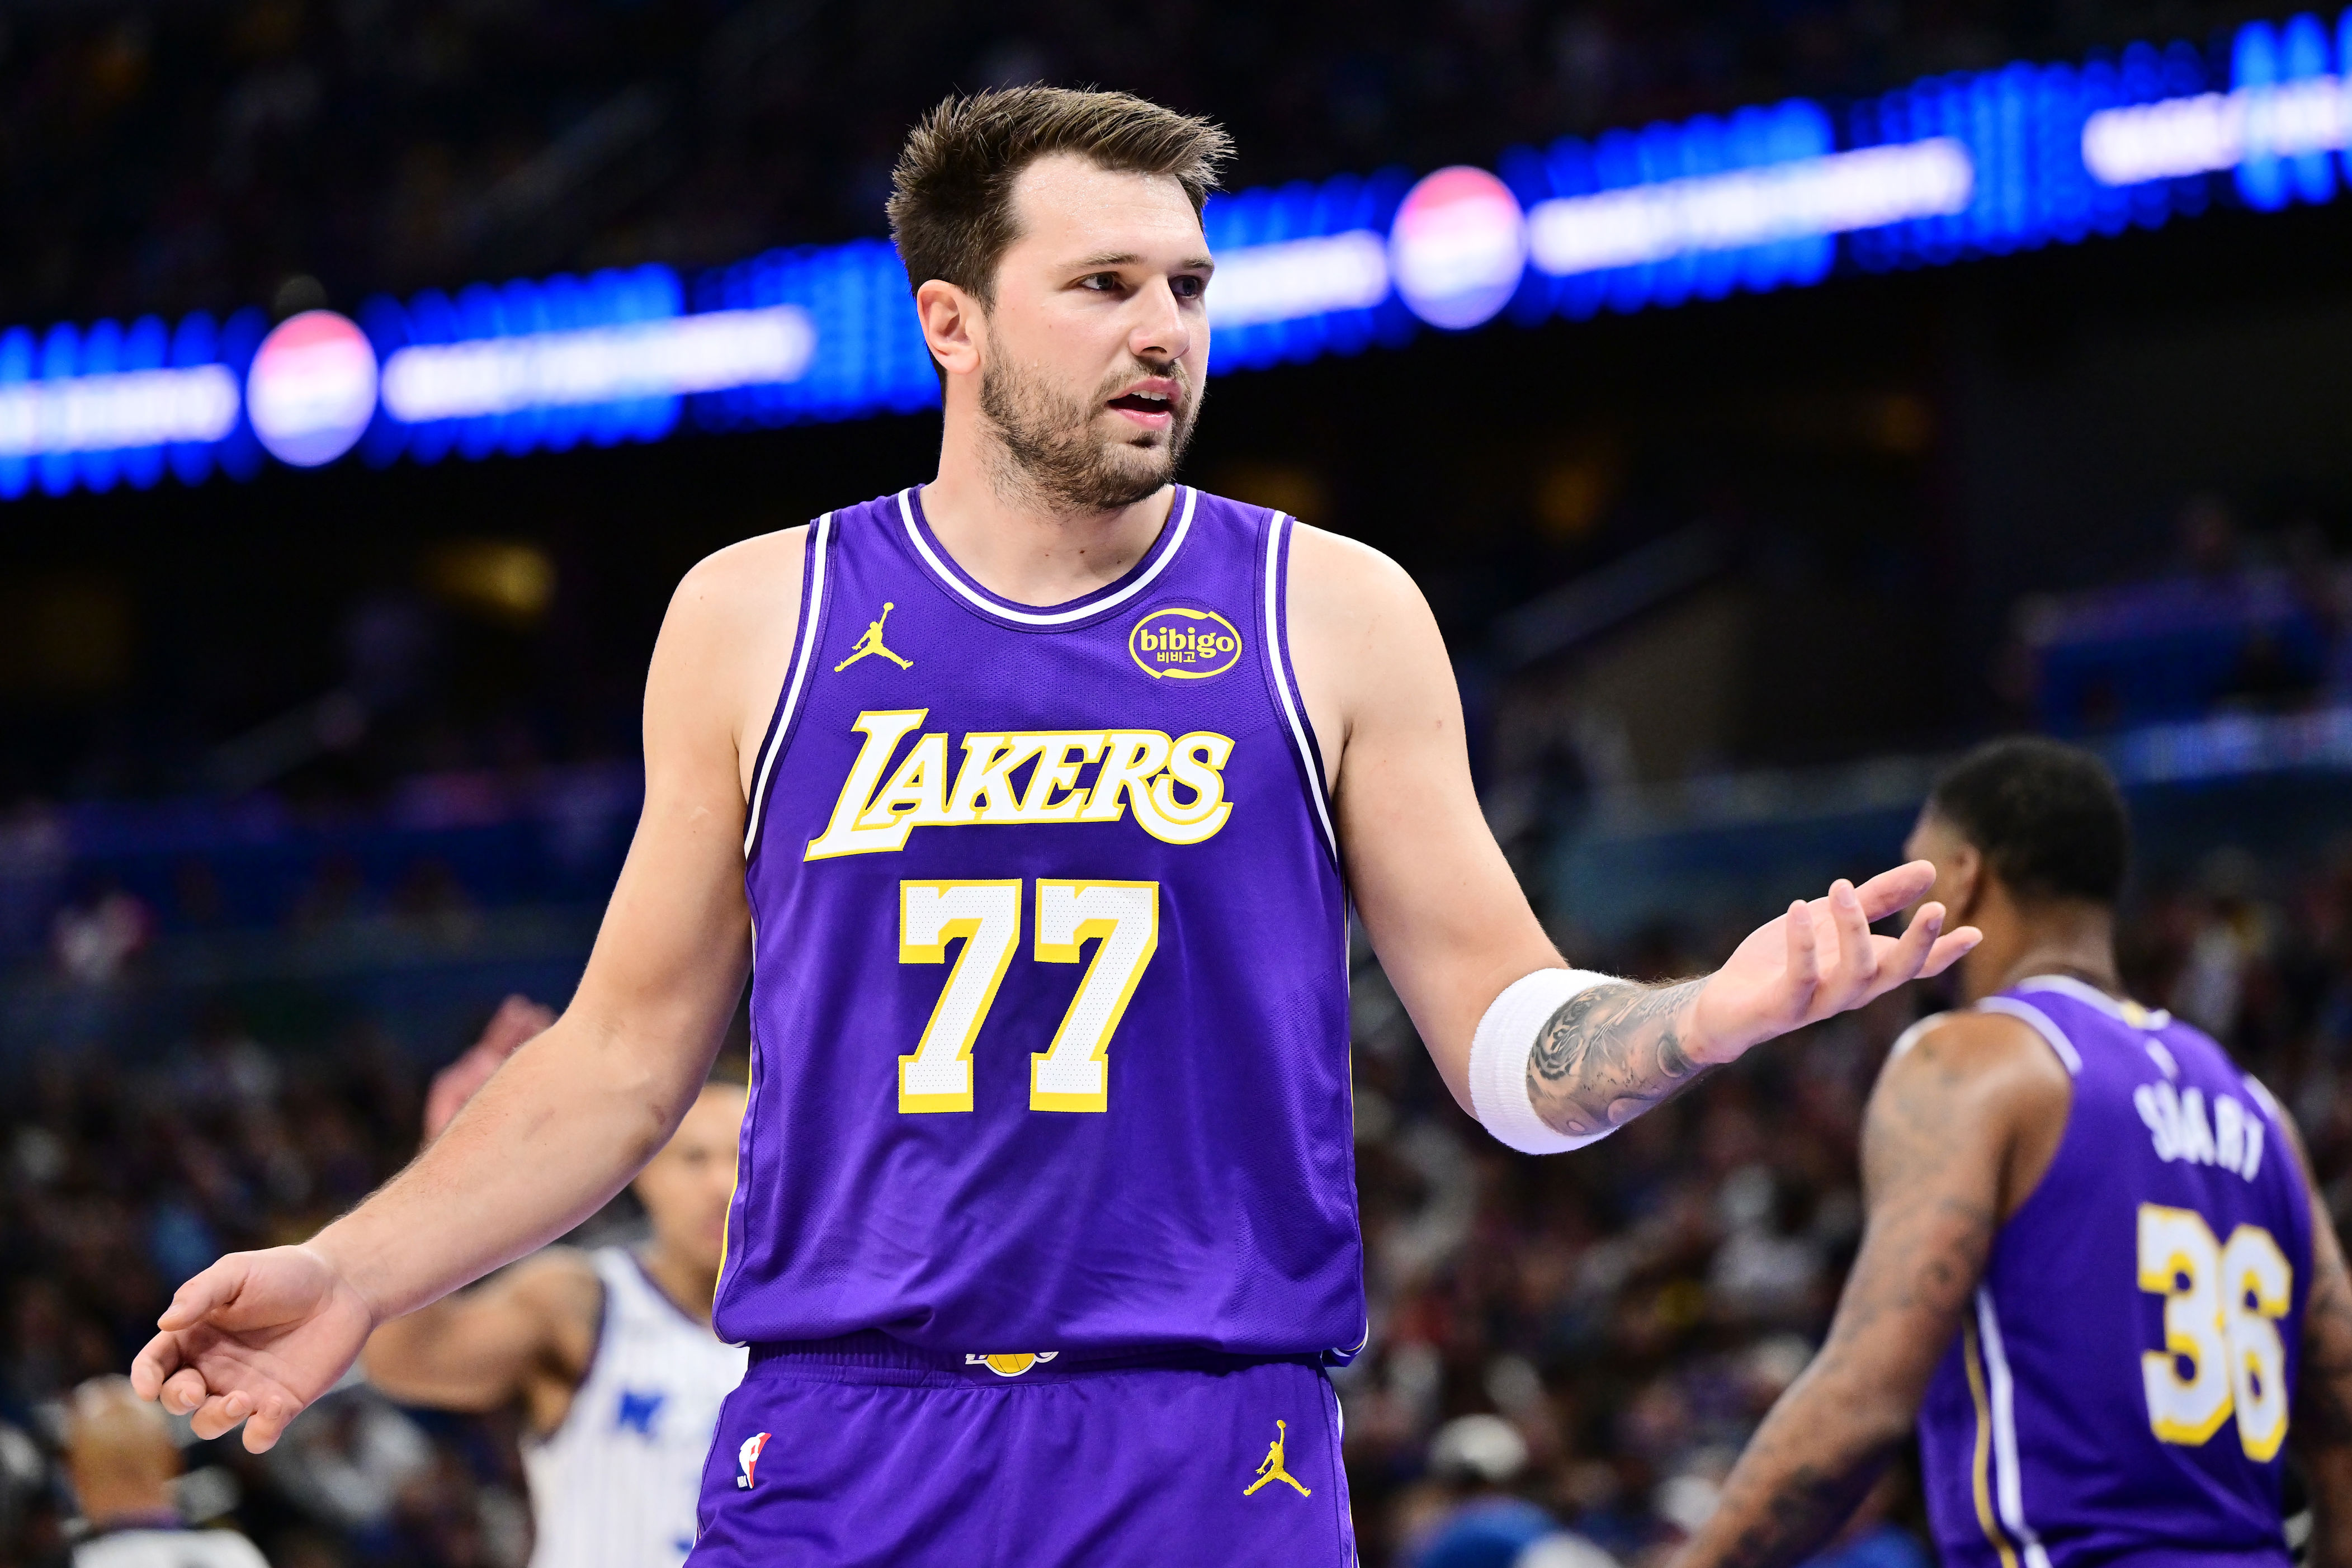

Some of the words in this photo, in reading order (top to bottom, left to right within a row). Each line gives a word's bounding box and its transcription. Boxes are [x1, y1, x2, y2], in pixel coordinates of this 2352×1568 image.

[1140, 627, 1235, 658] bibigo
[1156, 651, 1196, 663] 비비고
[804, 707, 1235, 862] LAKERS
[898, 878, 1160, 1114] 77
[2137, 1202, 2293, 1463] 36
[737, 1475, 748, 1488] NBA
